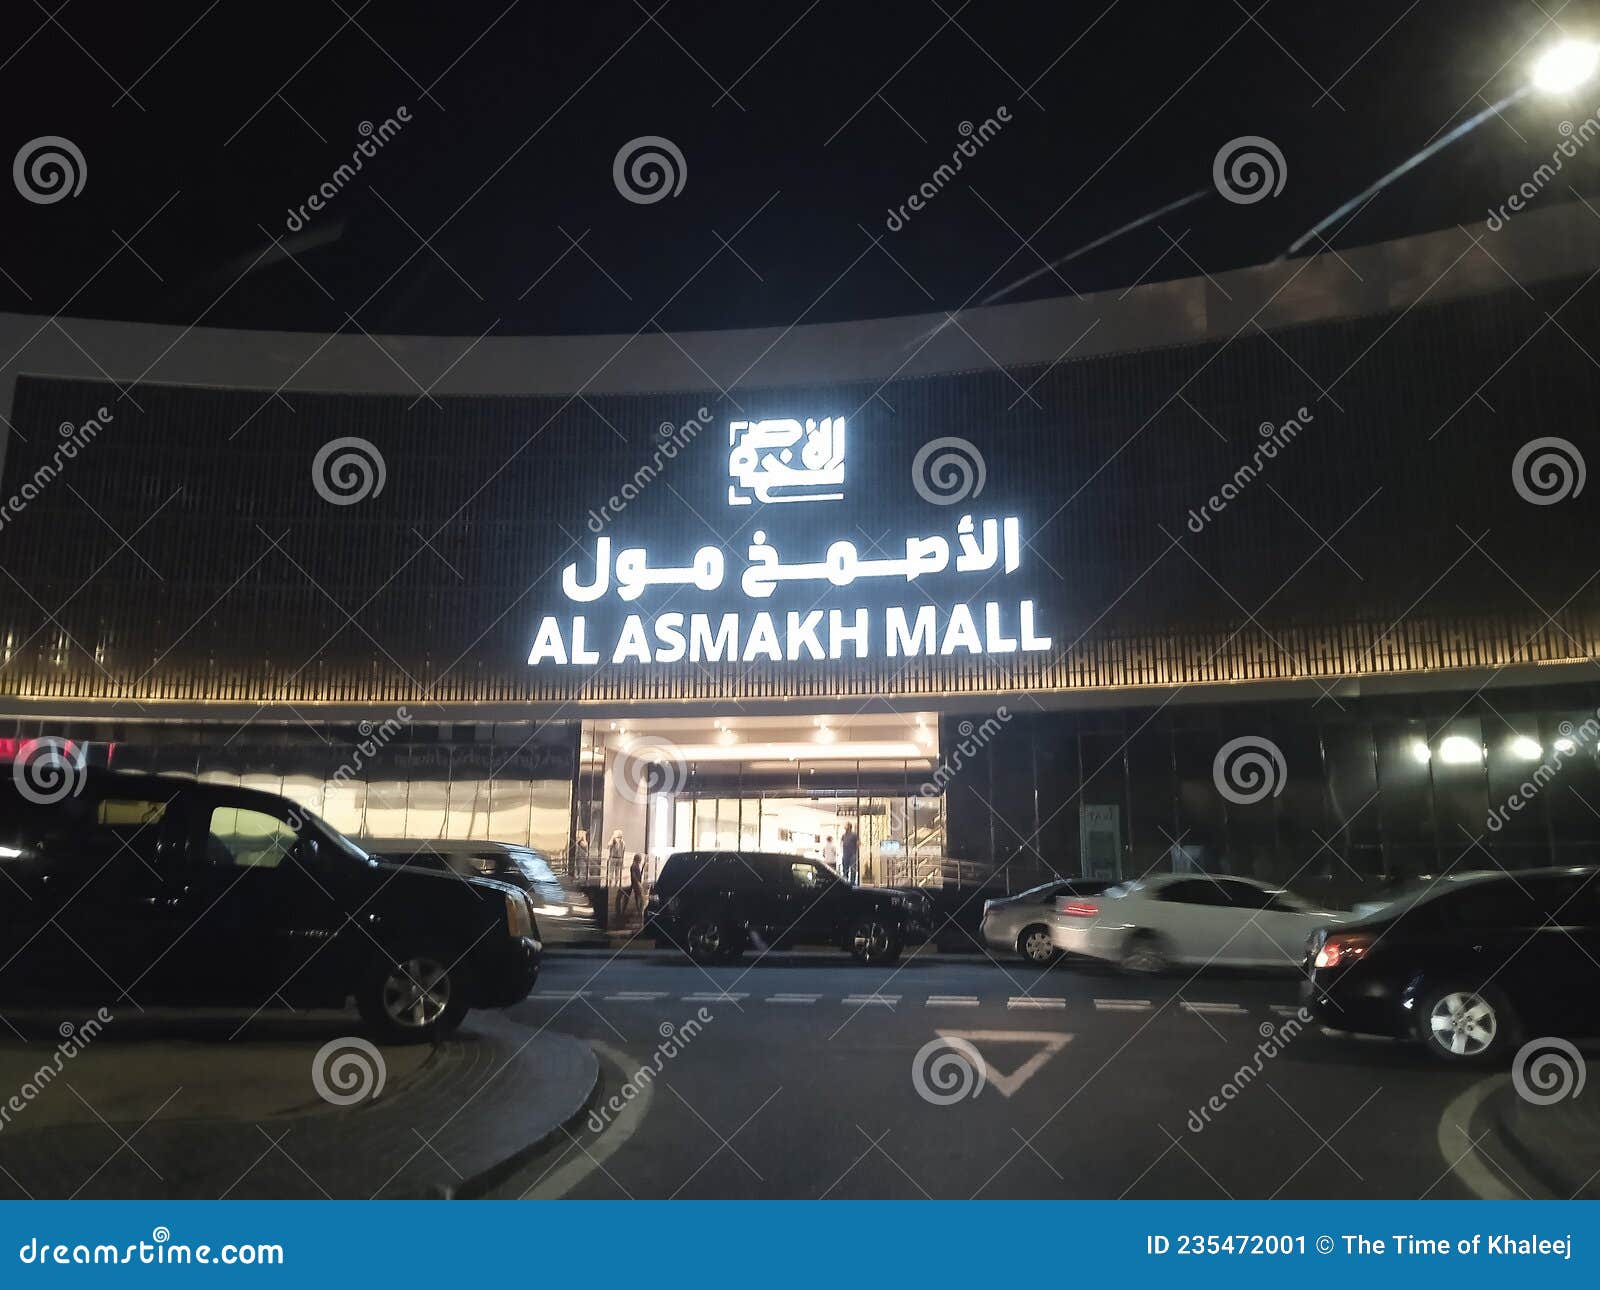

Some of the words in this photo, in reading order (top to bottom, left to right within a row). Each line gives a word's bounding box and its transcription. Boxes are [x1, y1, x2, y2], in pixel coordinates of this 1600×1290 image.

[562, 537, 725, 602] مول
[741, 515, 1020, 598] الأصمخ
[527, 616, 600, 665] AL
[612, 608, 869, 664] ASMAKH
[886, 600, 1052, 657] MALL
